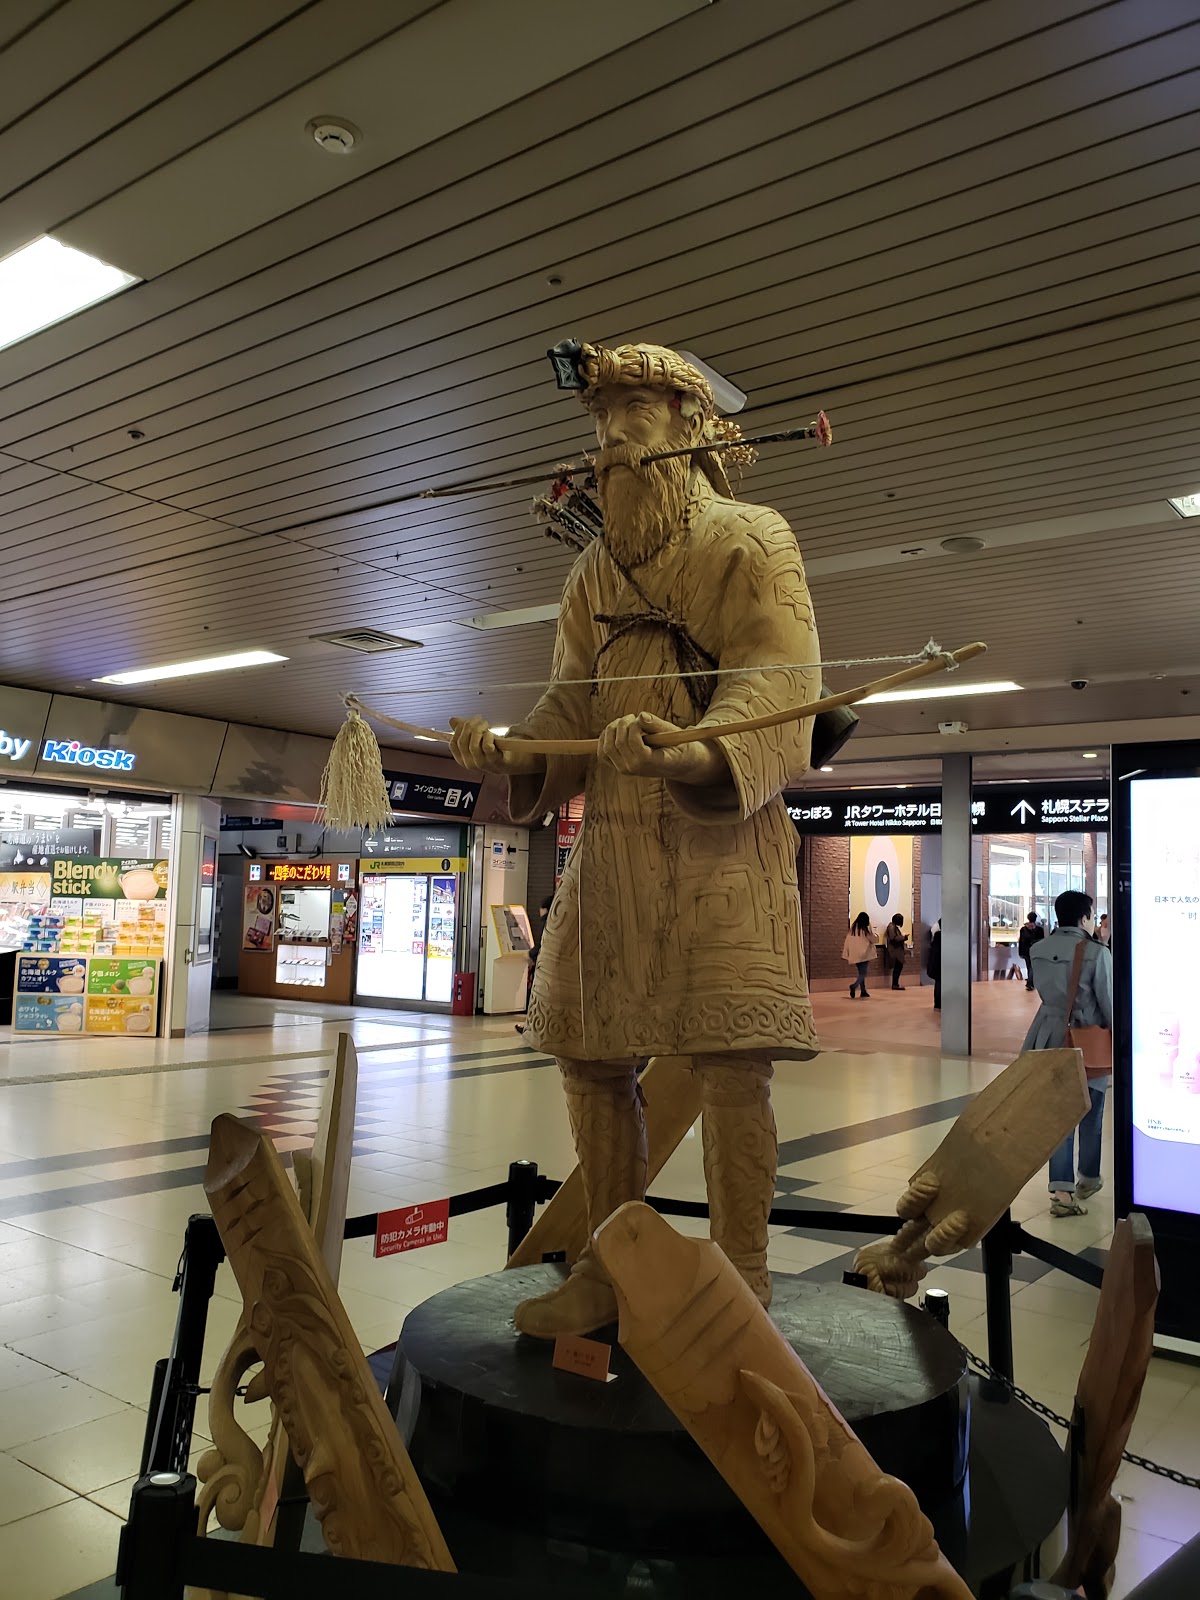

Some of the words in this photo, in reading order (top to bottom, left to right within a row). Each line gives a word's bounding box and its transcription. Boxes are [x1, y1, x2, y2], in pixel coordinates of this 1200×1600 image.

[42, 740, 136, 770] Kiosk
[414, 784, 447, 794] コインロッカー
[1041, 799, 1110, 814] 札幌ステラ
[902, 819, 926, 827] Sapporo
[1041, 815, 1068, 824] Sapporo
[1091, 814, 1108, 822] Place
[53, 860, 119, 880] Blendy
[370, 861, 380, 869] JR
[52, 879, 92, 895] stick
[1154, 895, 1200, 904] 日本で人気の
[380, 1220, 445, 1245] 防犯カメラ作動中
[380, 1242, 402, 1253] Security
[403, 1237, 425, 1247] Cameras
[433, 1233, 444, 1241] Use.
